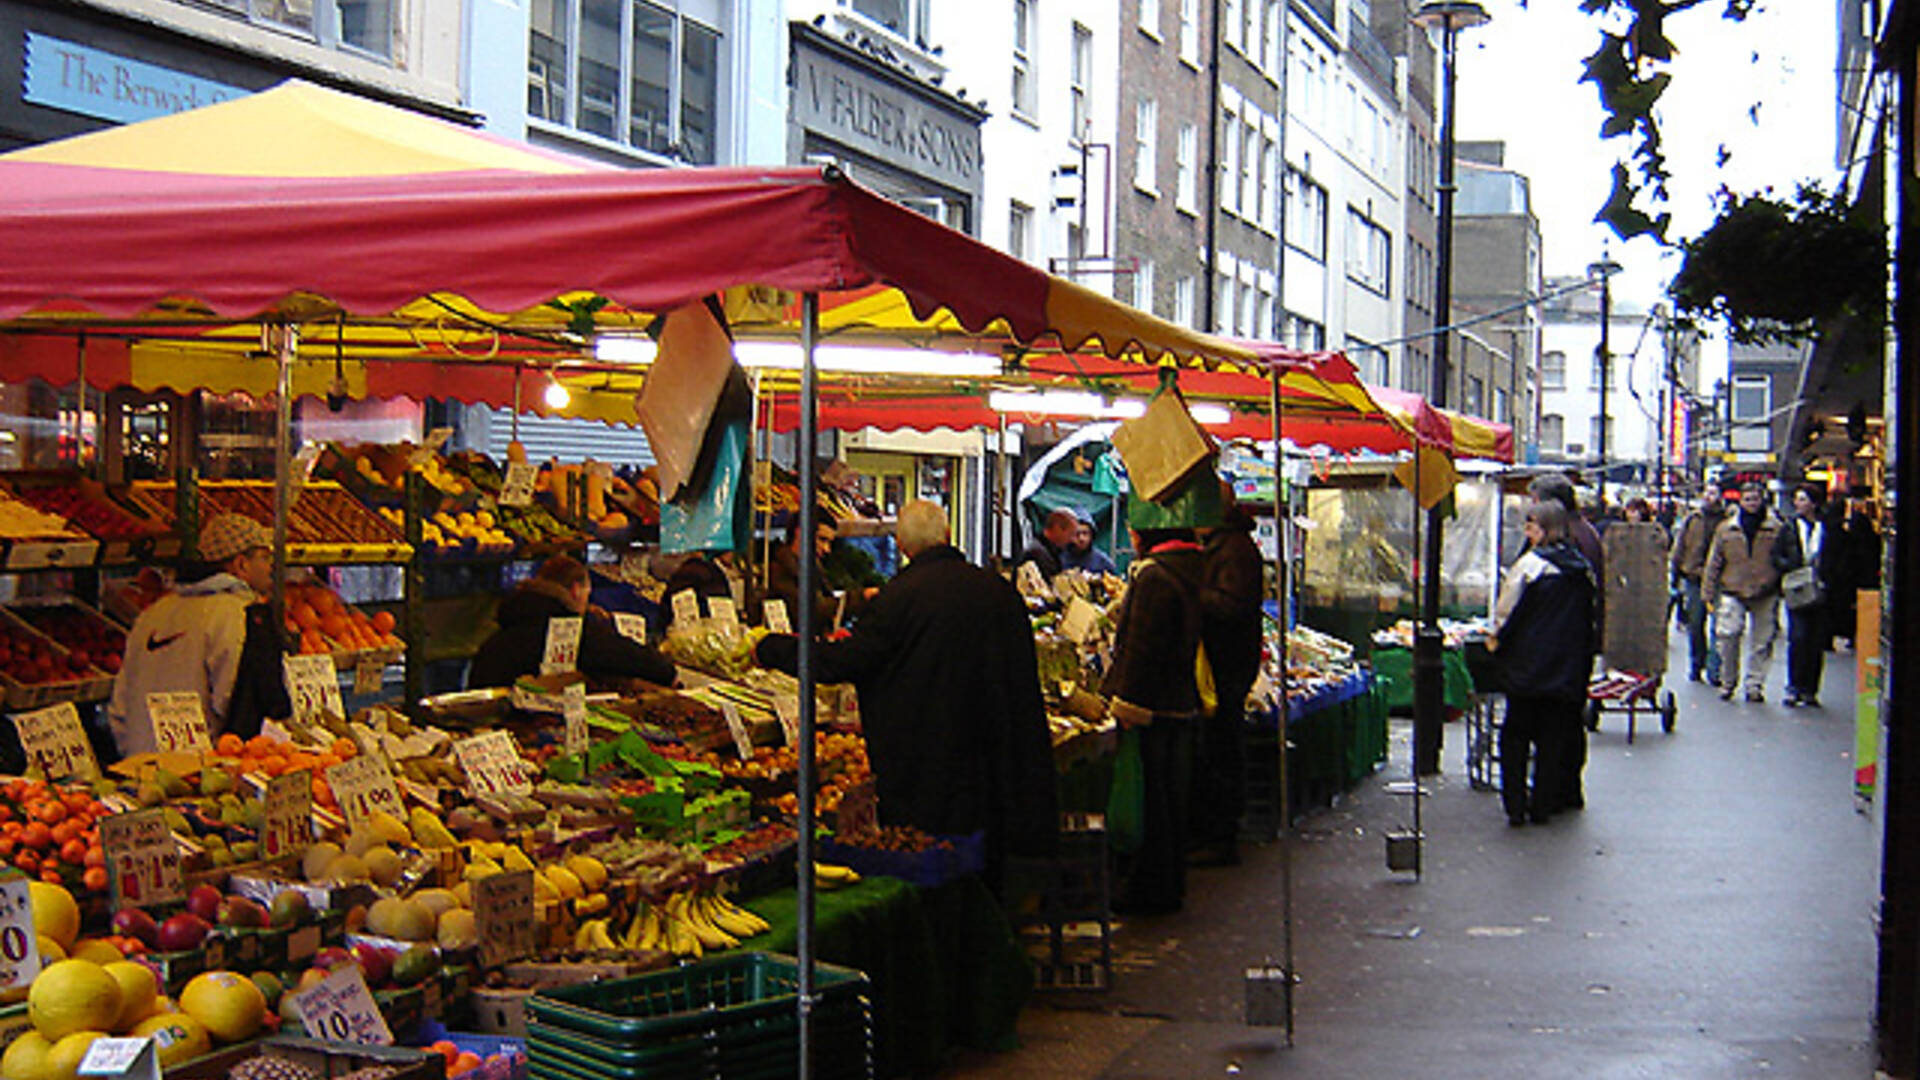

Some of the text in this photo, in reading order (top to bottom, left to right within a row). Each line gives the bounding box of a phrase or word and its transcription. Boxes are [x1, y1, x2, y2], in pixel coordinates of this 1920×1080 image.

[56, 50, 108, 97] The
[831, 73, 907, 155] FALBER
[917, 117, 973, 179] SONS
